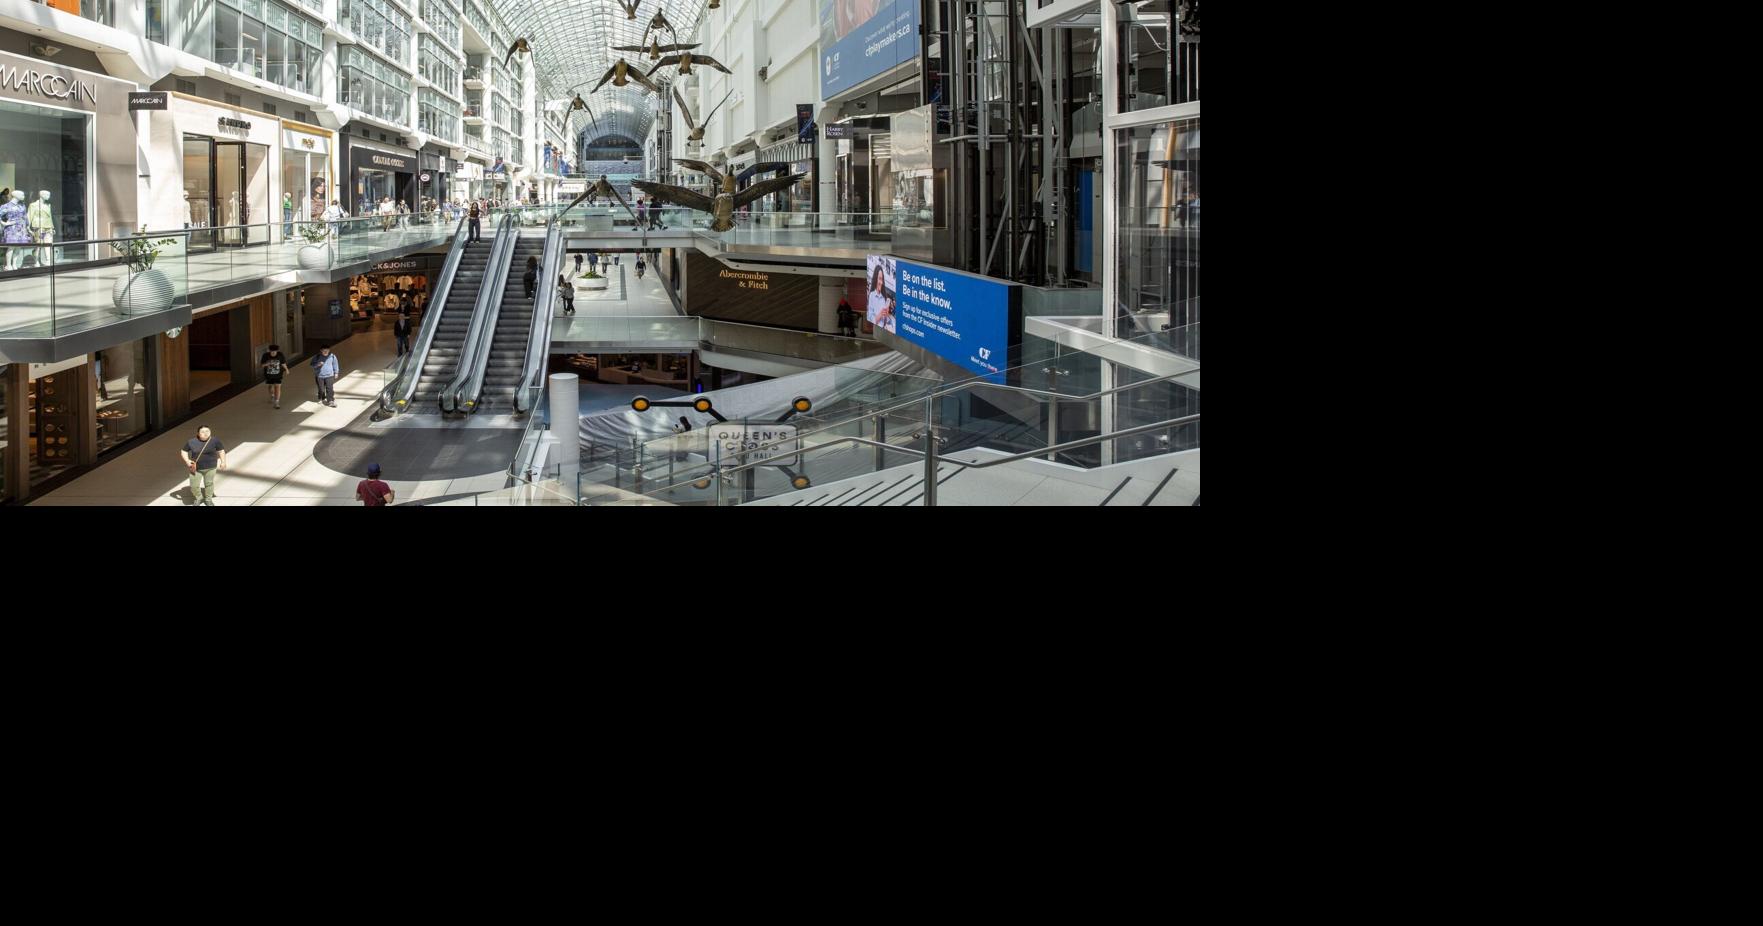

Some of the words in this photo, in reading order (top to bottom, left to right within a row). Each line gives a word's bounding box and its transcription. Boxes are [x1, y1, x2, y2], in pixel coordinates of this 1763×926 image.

[370, 261, 417, 270] CK&JONES
[719, 269, 769, 281] Abercrombie
[902, 270, 911, 282] Be
[911, 275, 920, 284] on
[921, 275, 932, 288] the
[933, 278, 946, 292] list.
[748, 280, 769, 290] Fitch
[902, 284, 911, 296] Be
[911, 287, 919, 299] in
[918, 290, 930, 303] the
[931, 292, 952, 310] know.
[921, 309, 940, 322] exclusive
[940, 315, 953, 327] offers
[979, 347, 991, 360] CF
[718, 431, 787, 440] QUEEN'S
